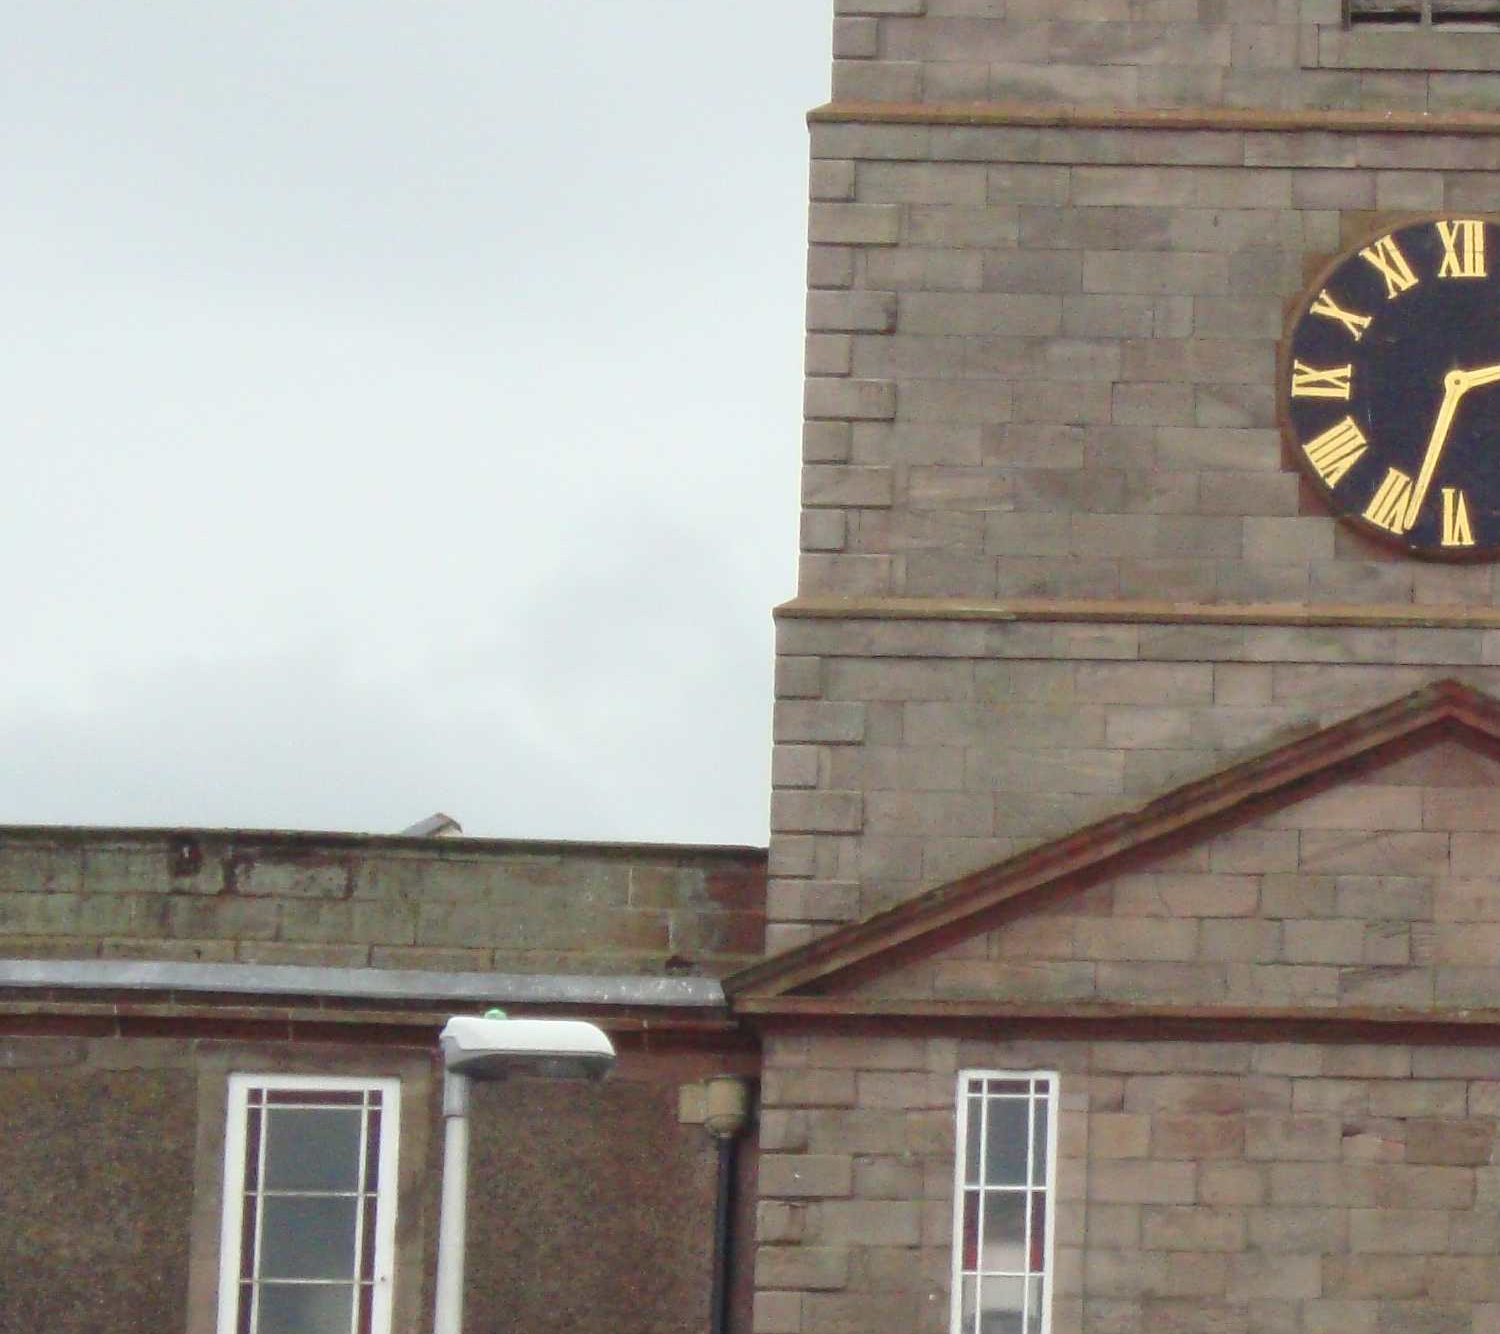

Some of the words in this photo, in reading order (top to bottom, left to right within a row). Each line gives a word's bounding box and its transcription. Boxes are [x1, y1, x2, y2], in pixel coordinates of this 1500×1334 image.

[1359, 234, 1418, 299] XI
[1435, 219, 1486, 277] XII
[1310, 289, 1372, 342] X
[1292, 359, 1351, 400] IX
[1302, 415, 1368, 489] VIII
[1361, 467, 1413, 535] VII
[1441, 488, 1475, 546] VI
